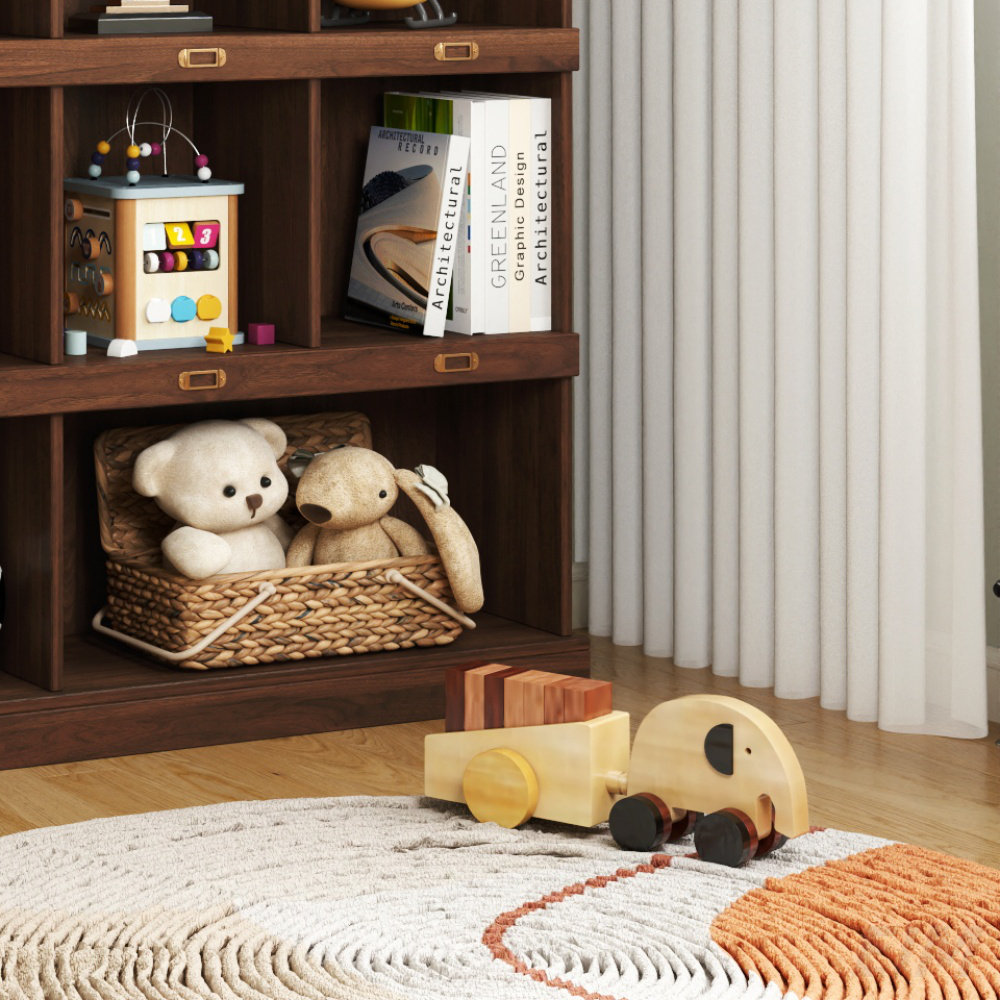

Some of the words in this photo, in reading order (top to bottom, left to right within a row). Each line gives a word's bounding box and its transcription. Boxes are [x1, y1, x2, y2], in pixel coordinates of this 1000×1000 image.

[397, 141, 439, 156] RECORD
[513, 152, 527, 209] Design
[533, 130, 548, 286] Architectural
[173, 226, 186, 242] 2
[199, 228, 212, 245] 3
[431, 166, 463, 311] Architectural
[490, 145, 507, 289] GREENLAND
[513, 215, 527, 282] Graphic
